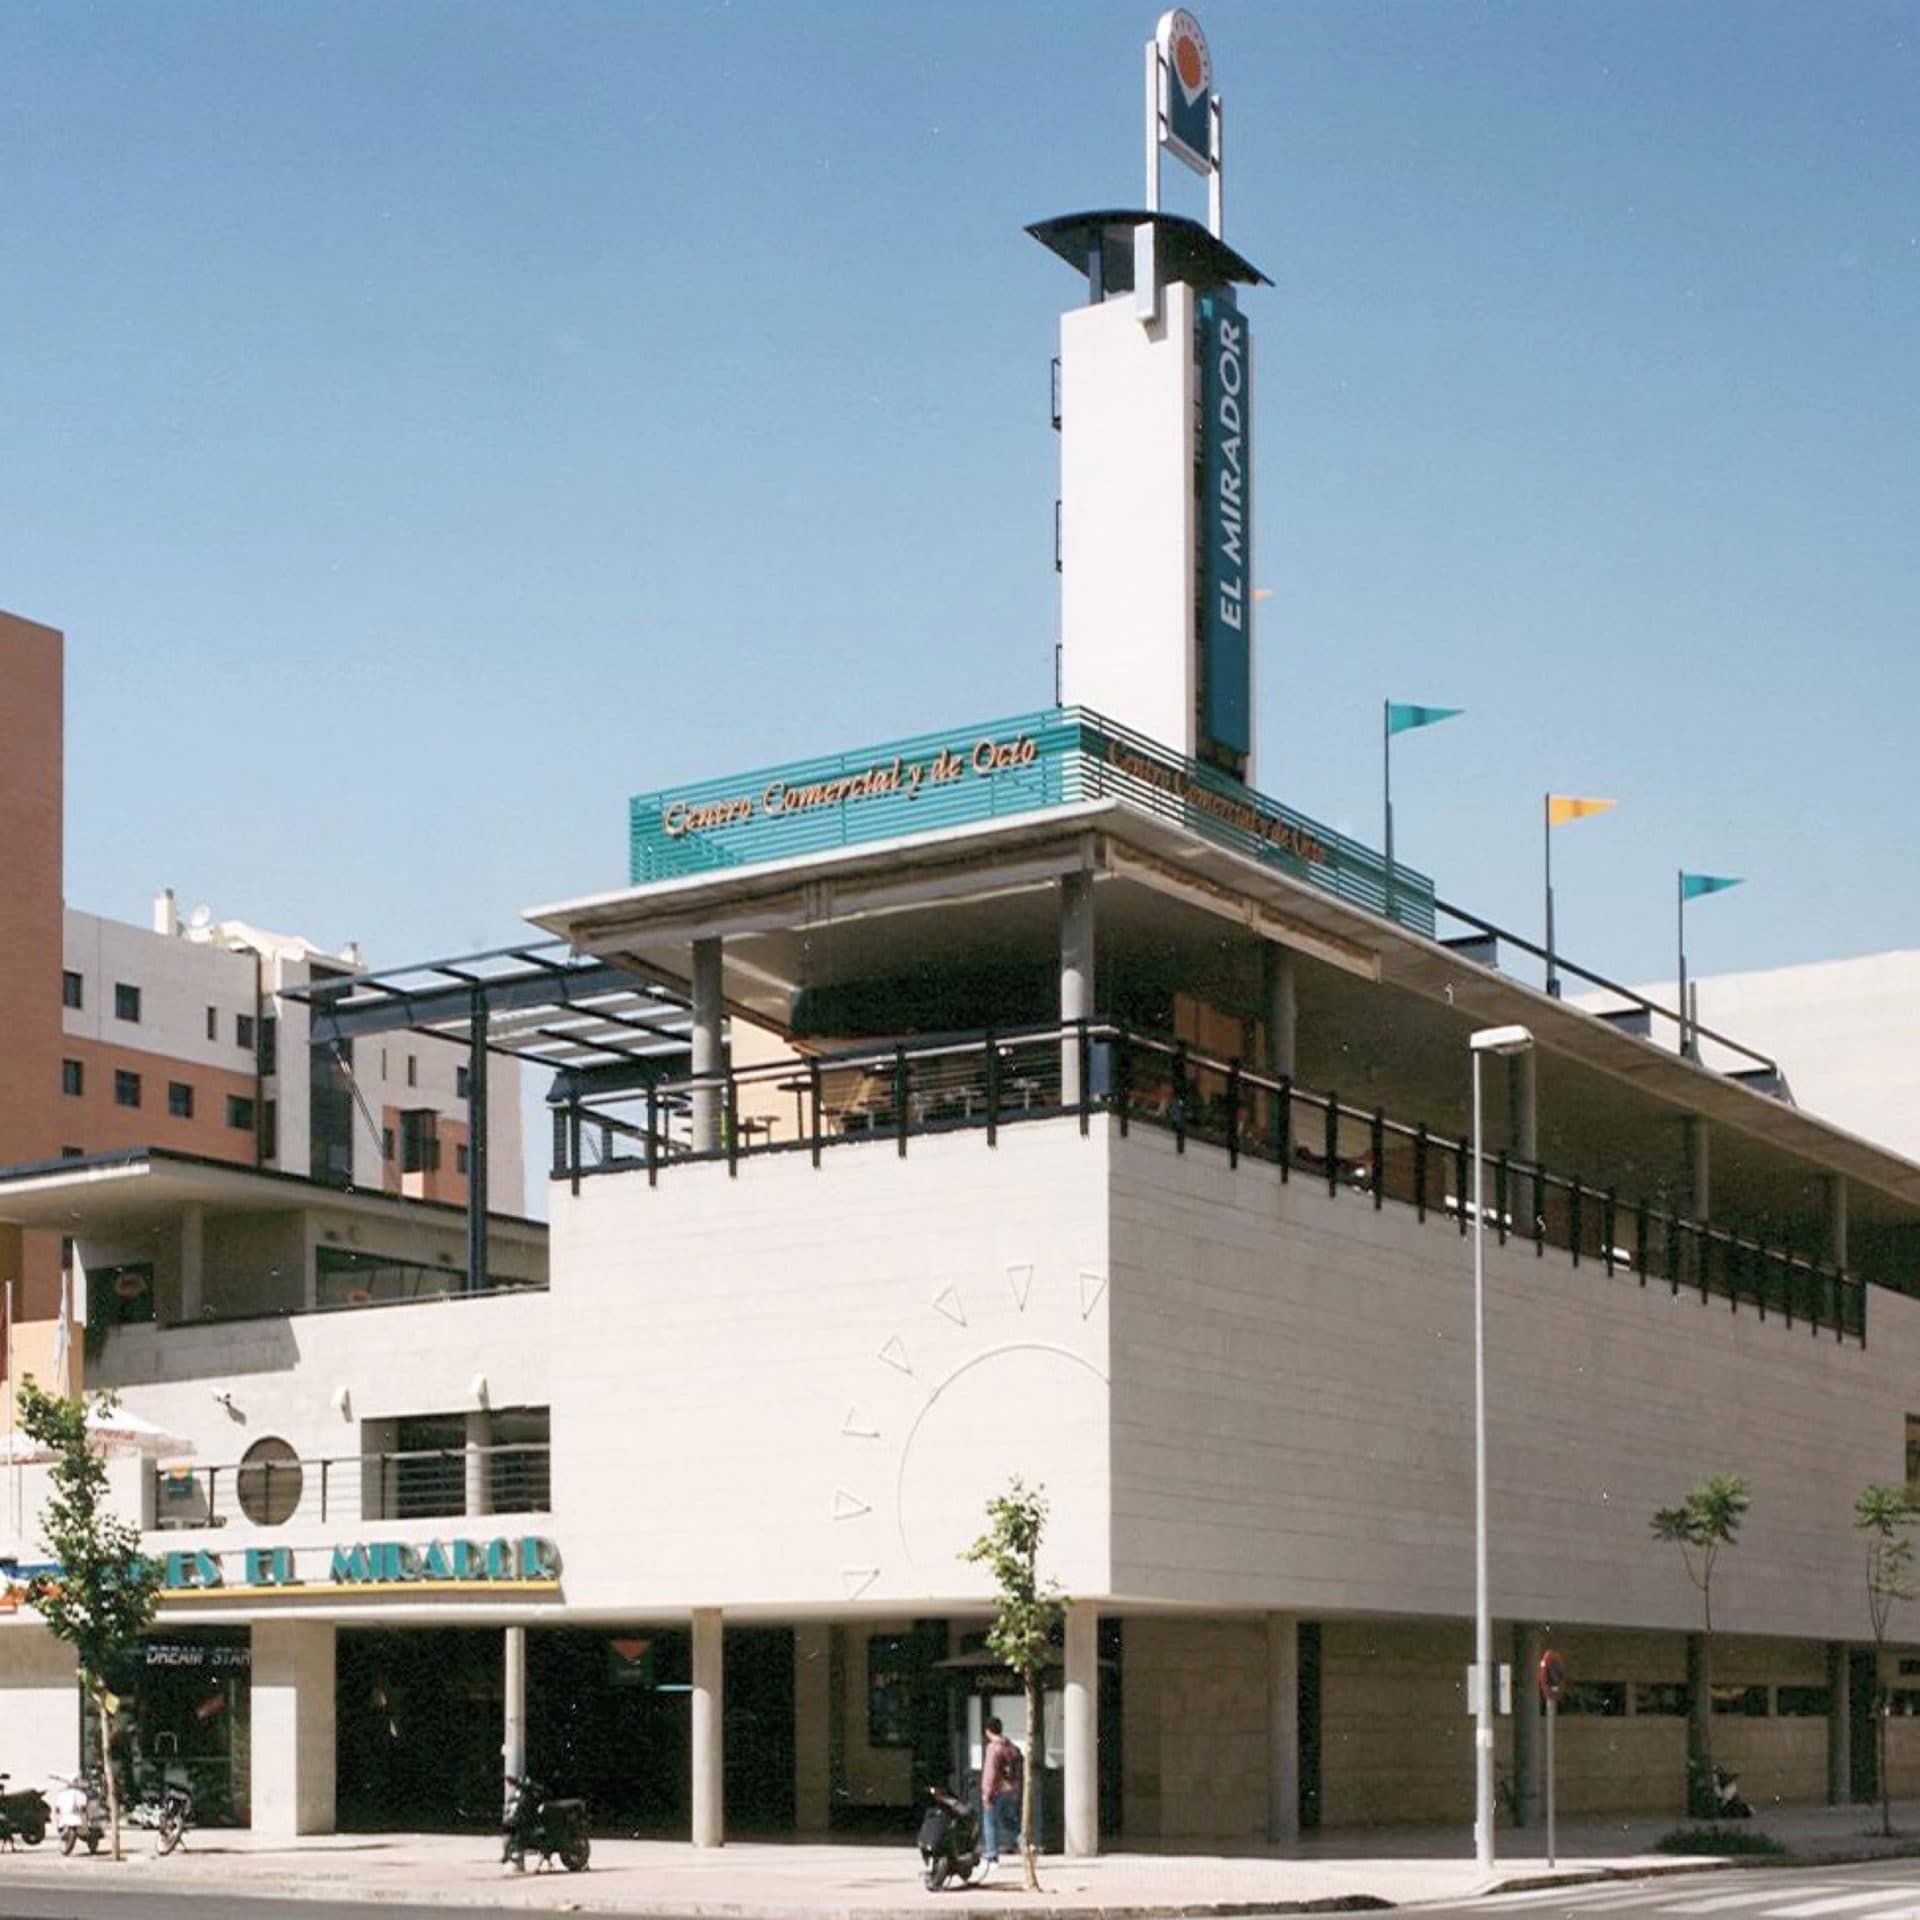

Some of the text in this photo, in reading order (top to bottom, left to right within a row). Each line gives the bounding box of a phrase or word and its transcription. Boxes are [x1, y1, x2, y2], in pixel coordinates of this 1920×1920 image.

[1219, 317, 1241, 631] EL MIRADOR
[663, 733, 1037, 837] Centro Comercial y de Ocio
[245, 1546, 304, 1586] EL
[331, 1535, 563, 1585] MIRADOR
